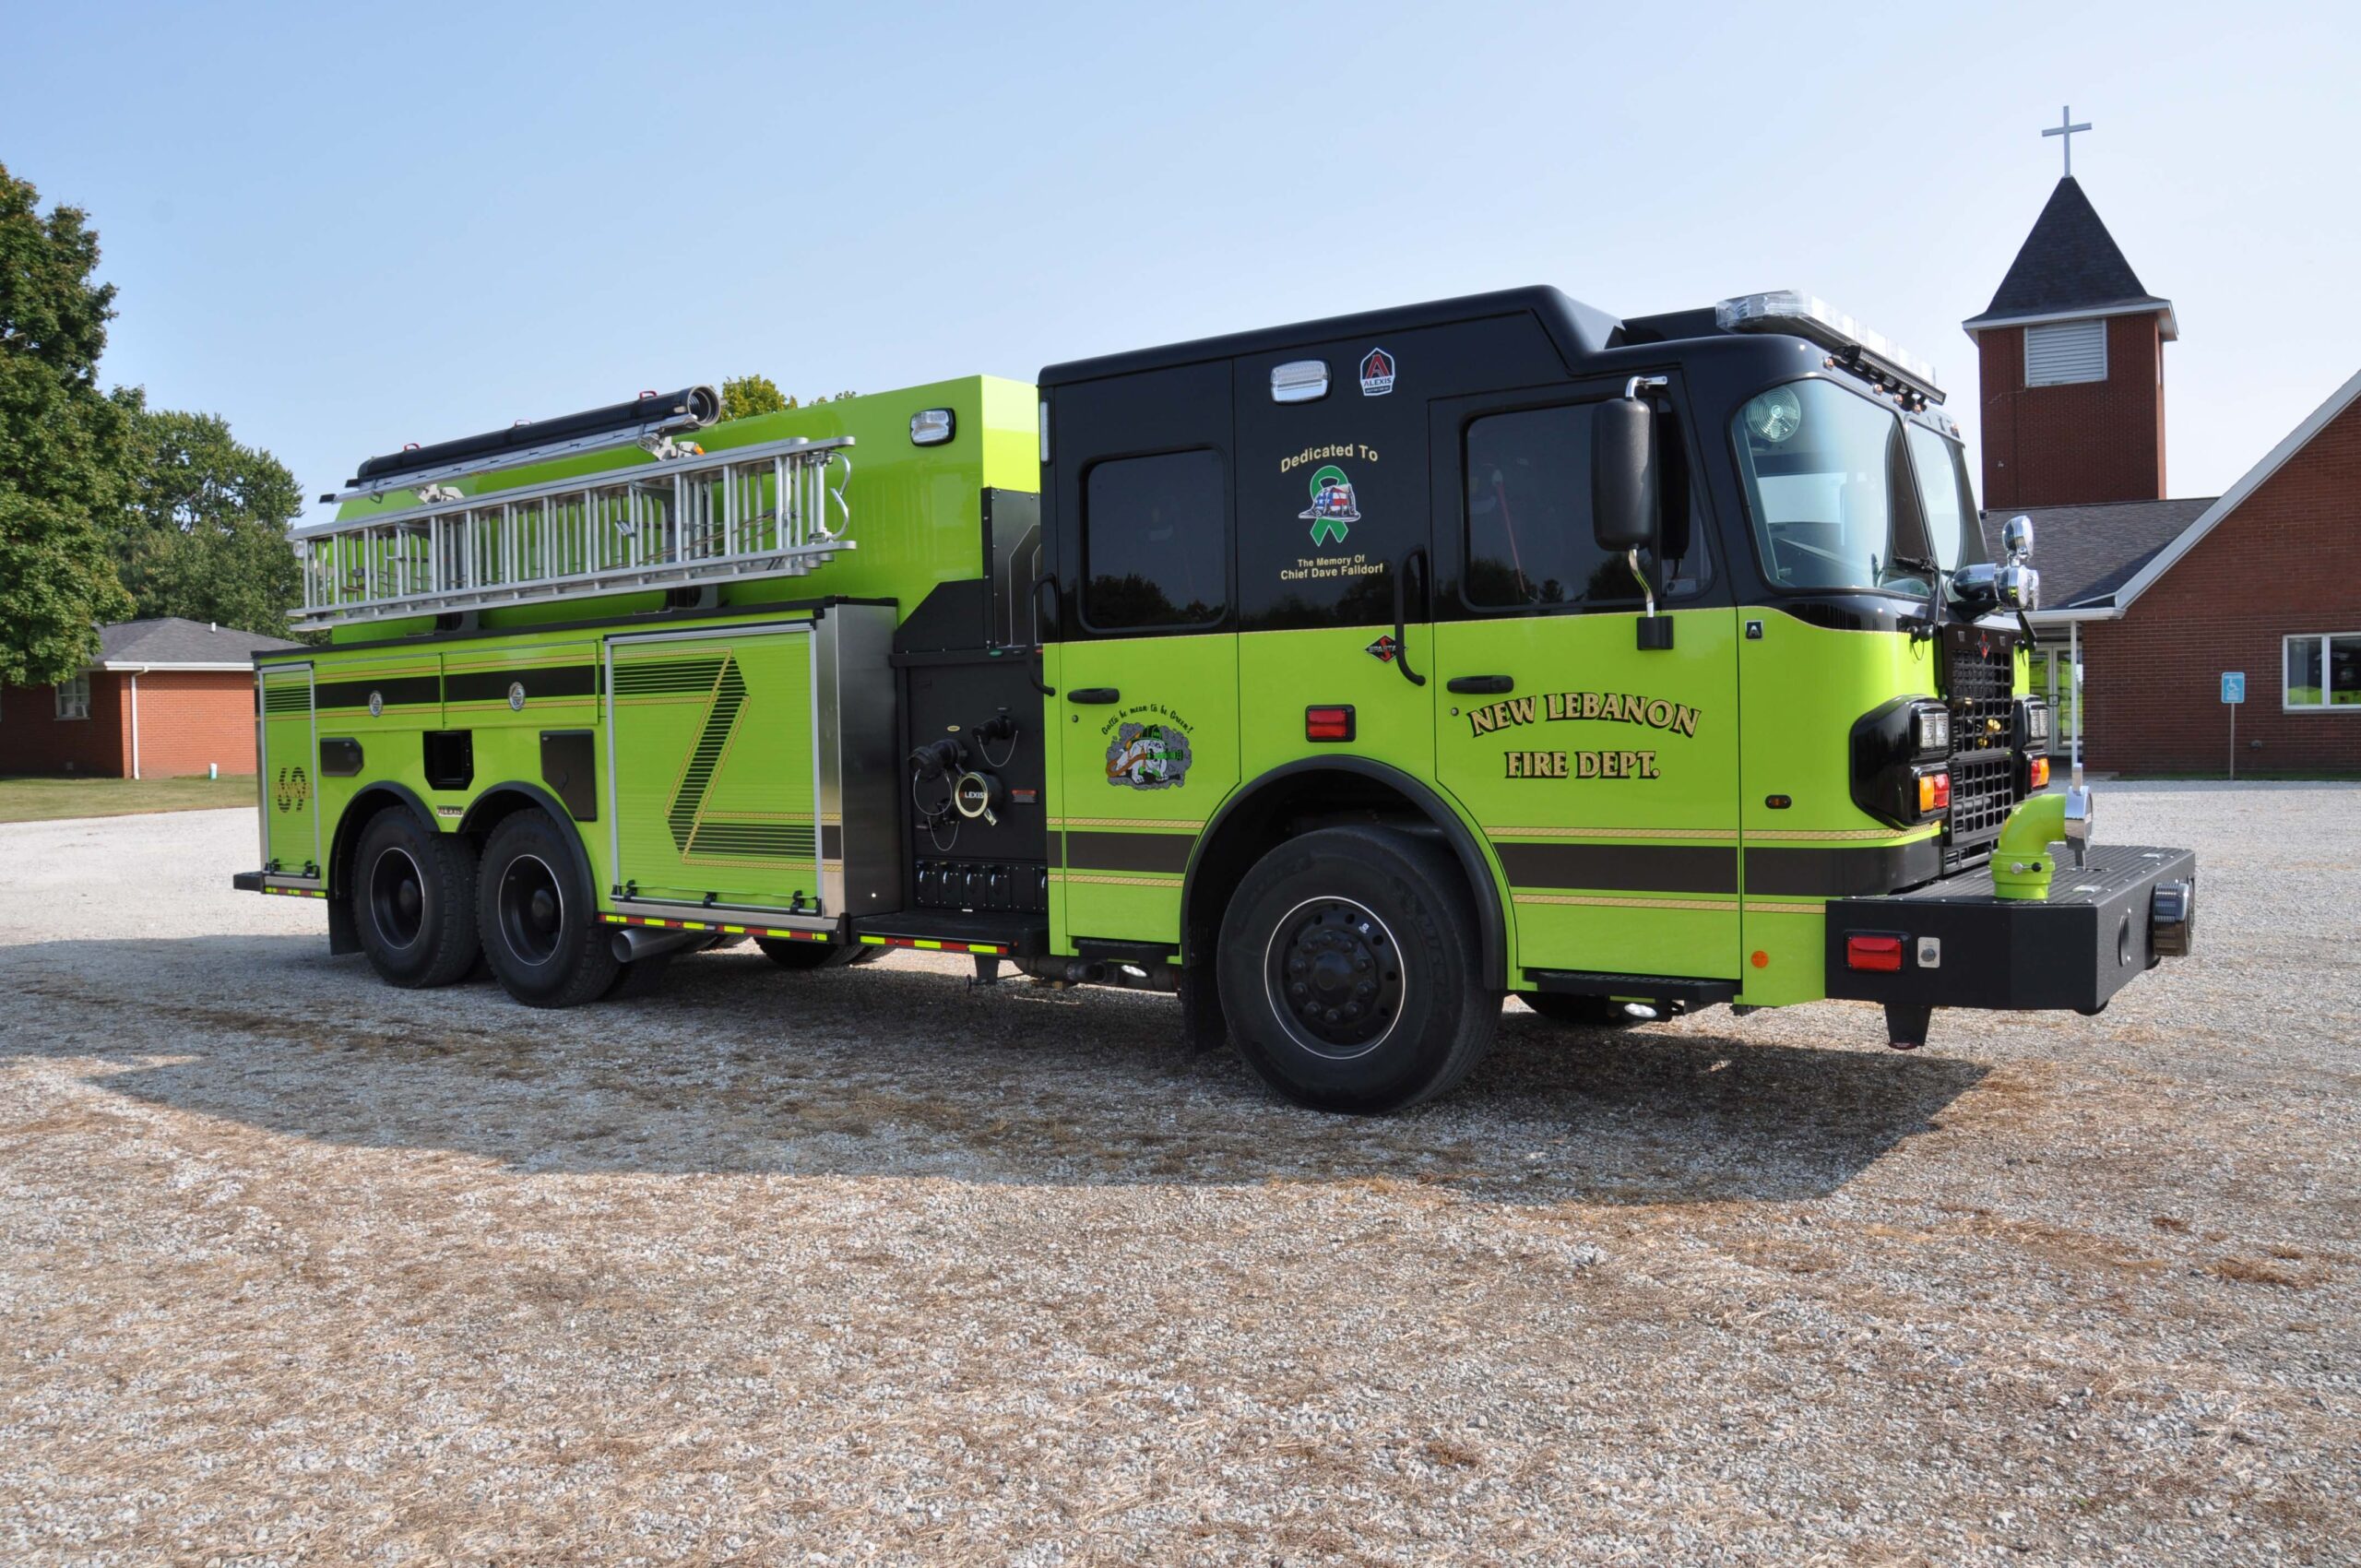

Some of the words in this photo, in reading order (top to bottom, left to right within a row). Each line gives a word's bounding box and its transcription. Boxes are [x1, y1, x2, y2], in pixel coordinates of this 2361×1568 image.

[1364, 377, 1392, 386] ALEXIS
[1280, 444, 1353, 473] Dedicated
[1358, 445, 1378, 461] To
[1281, 569, 1308, 580] Chief
[1311, 567, 1337, 577] Dave
[1341, 563, 1384, 576] Falldorf
[1298, 559, 1313, 567] The
[1317, 557, 1351, 566] Memory
[1355, 554, 1365, 563] Of
[1467, 695, 1536, 738] NEW
[1544, 693, 1702, 738] LEBANON
[1504, 752, 1569, 778] FIRE
[1574, 751, 1660, 778] DEPT.
